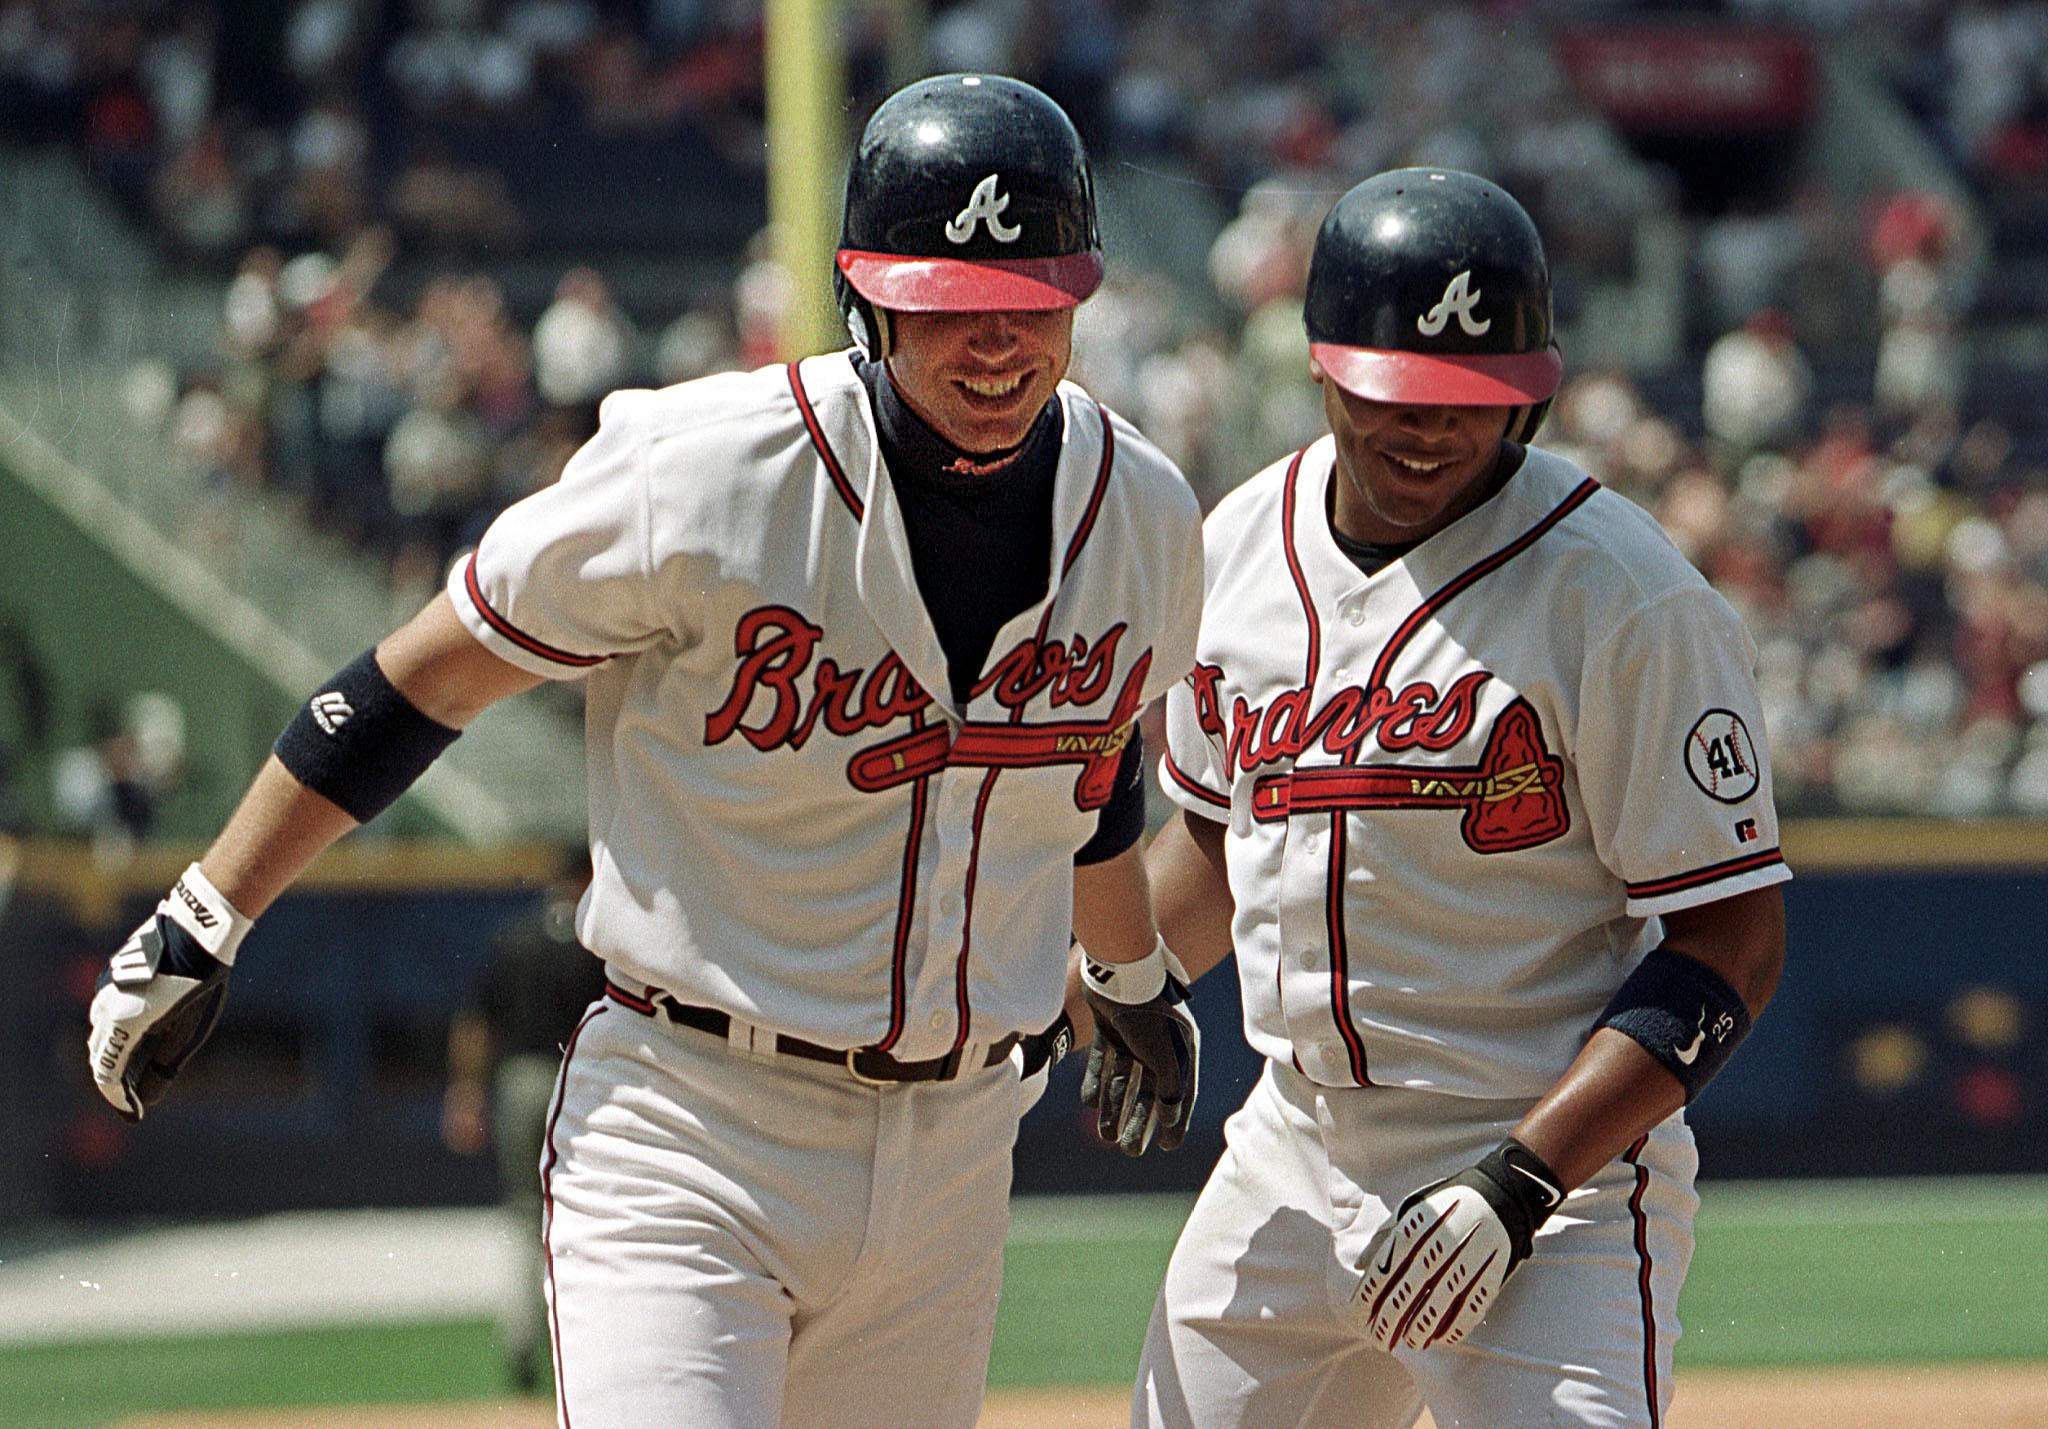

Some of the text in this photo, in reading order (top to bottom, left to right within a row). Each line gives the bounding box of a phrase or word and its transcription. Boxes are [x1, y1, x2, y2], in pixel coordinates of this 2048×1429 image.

[945, 173, 1021, 244] A
[1417, 269, 1491, 336] A
[1707, 733, 1745, 779] 41
[1712, 1011, 1734, 1044] 25
